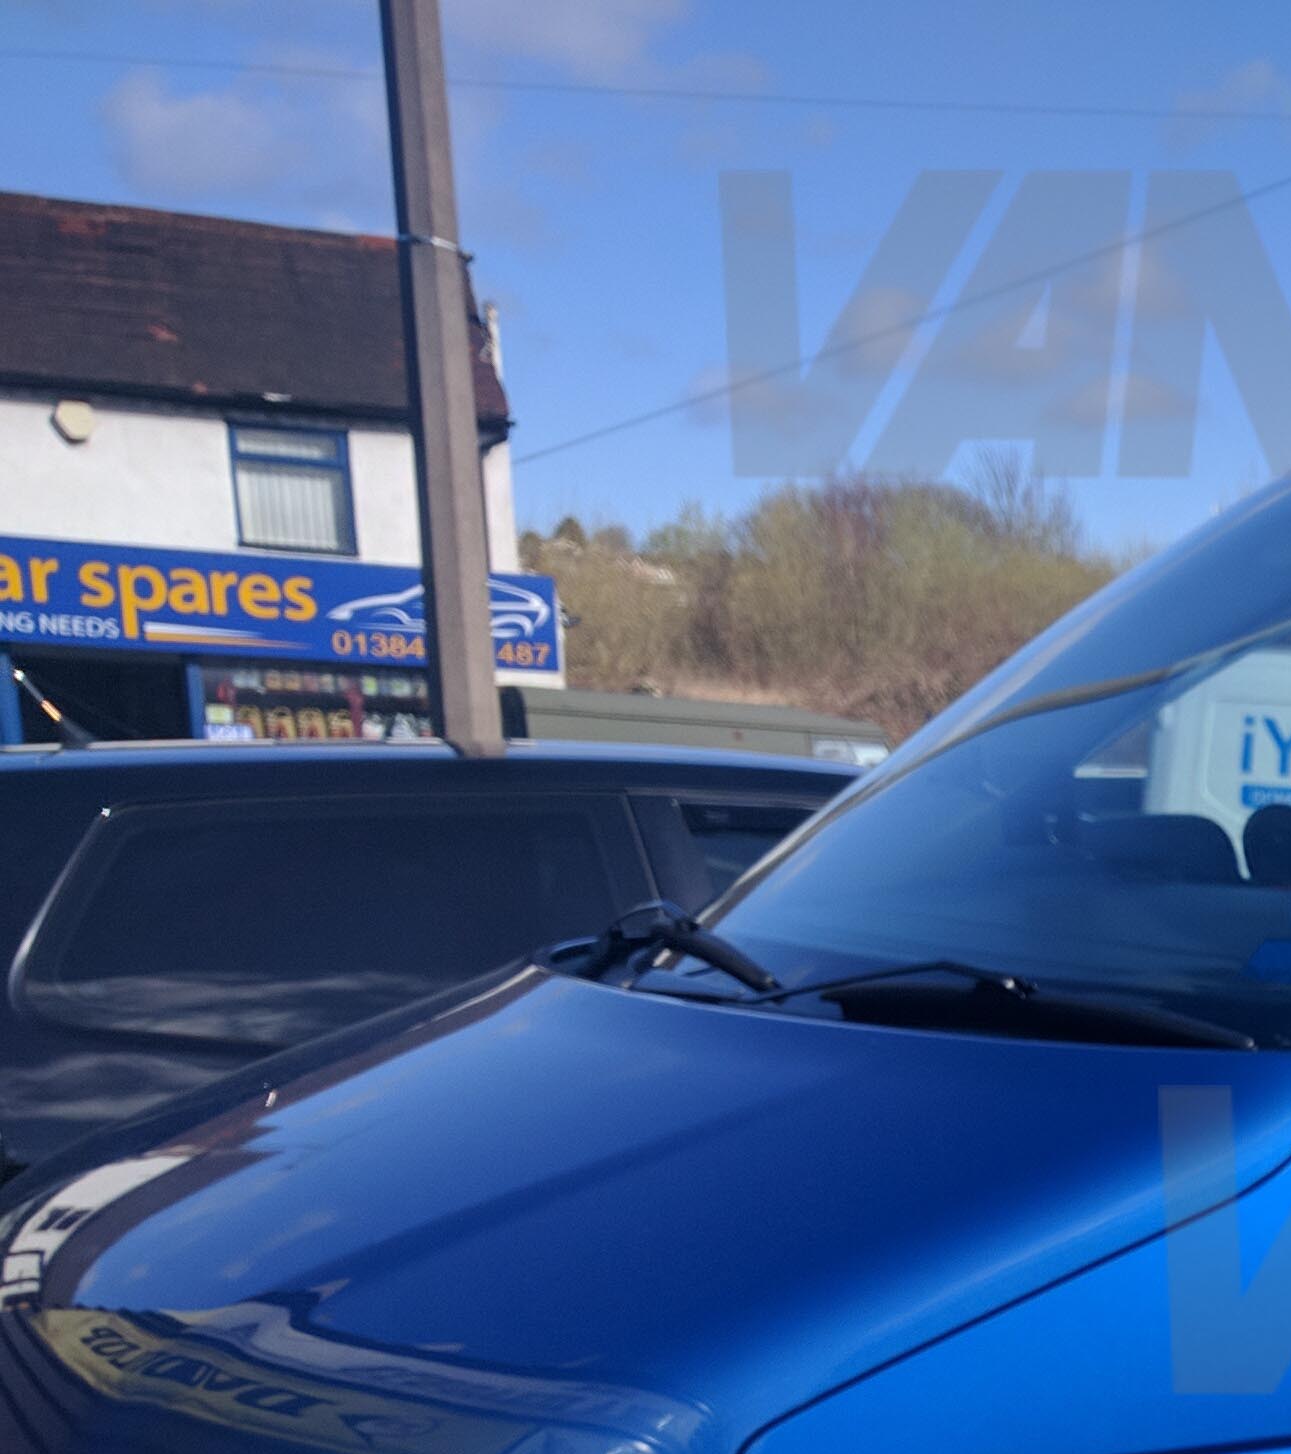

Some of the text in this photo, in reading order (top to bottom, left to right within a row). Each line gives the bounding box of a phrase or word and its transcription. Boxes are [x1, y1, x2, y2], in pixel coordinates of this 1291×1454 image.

[0, 553, 319, 639] ar spares
[38, 613, 120, 639] NEEDS
[331, 629, 427, 660] 01384
